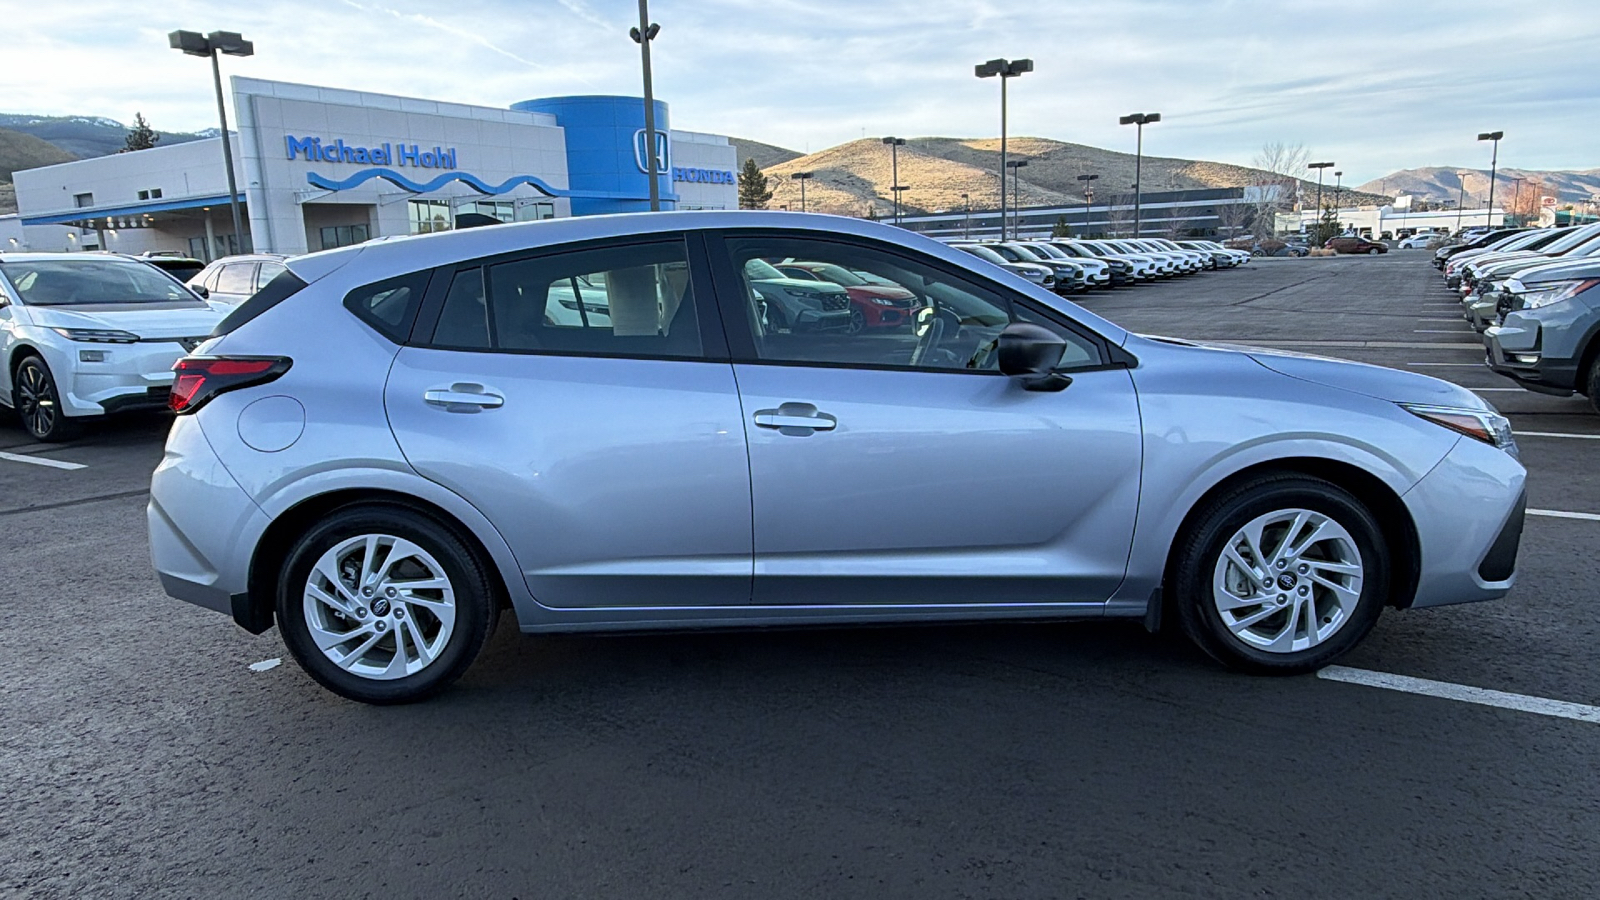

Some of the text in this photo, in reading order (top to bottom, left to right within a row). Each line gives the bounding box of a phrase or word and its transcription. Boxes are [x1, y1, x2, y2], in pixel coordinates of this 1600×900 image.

[285, 134, 458, 169] Michael Hohl
[673, 166, 736, 185] HONDA
